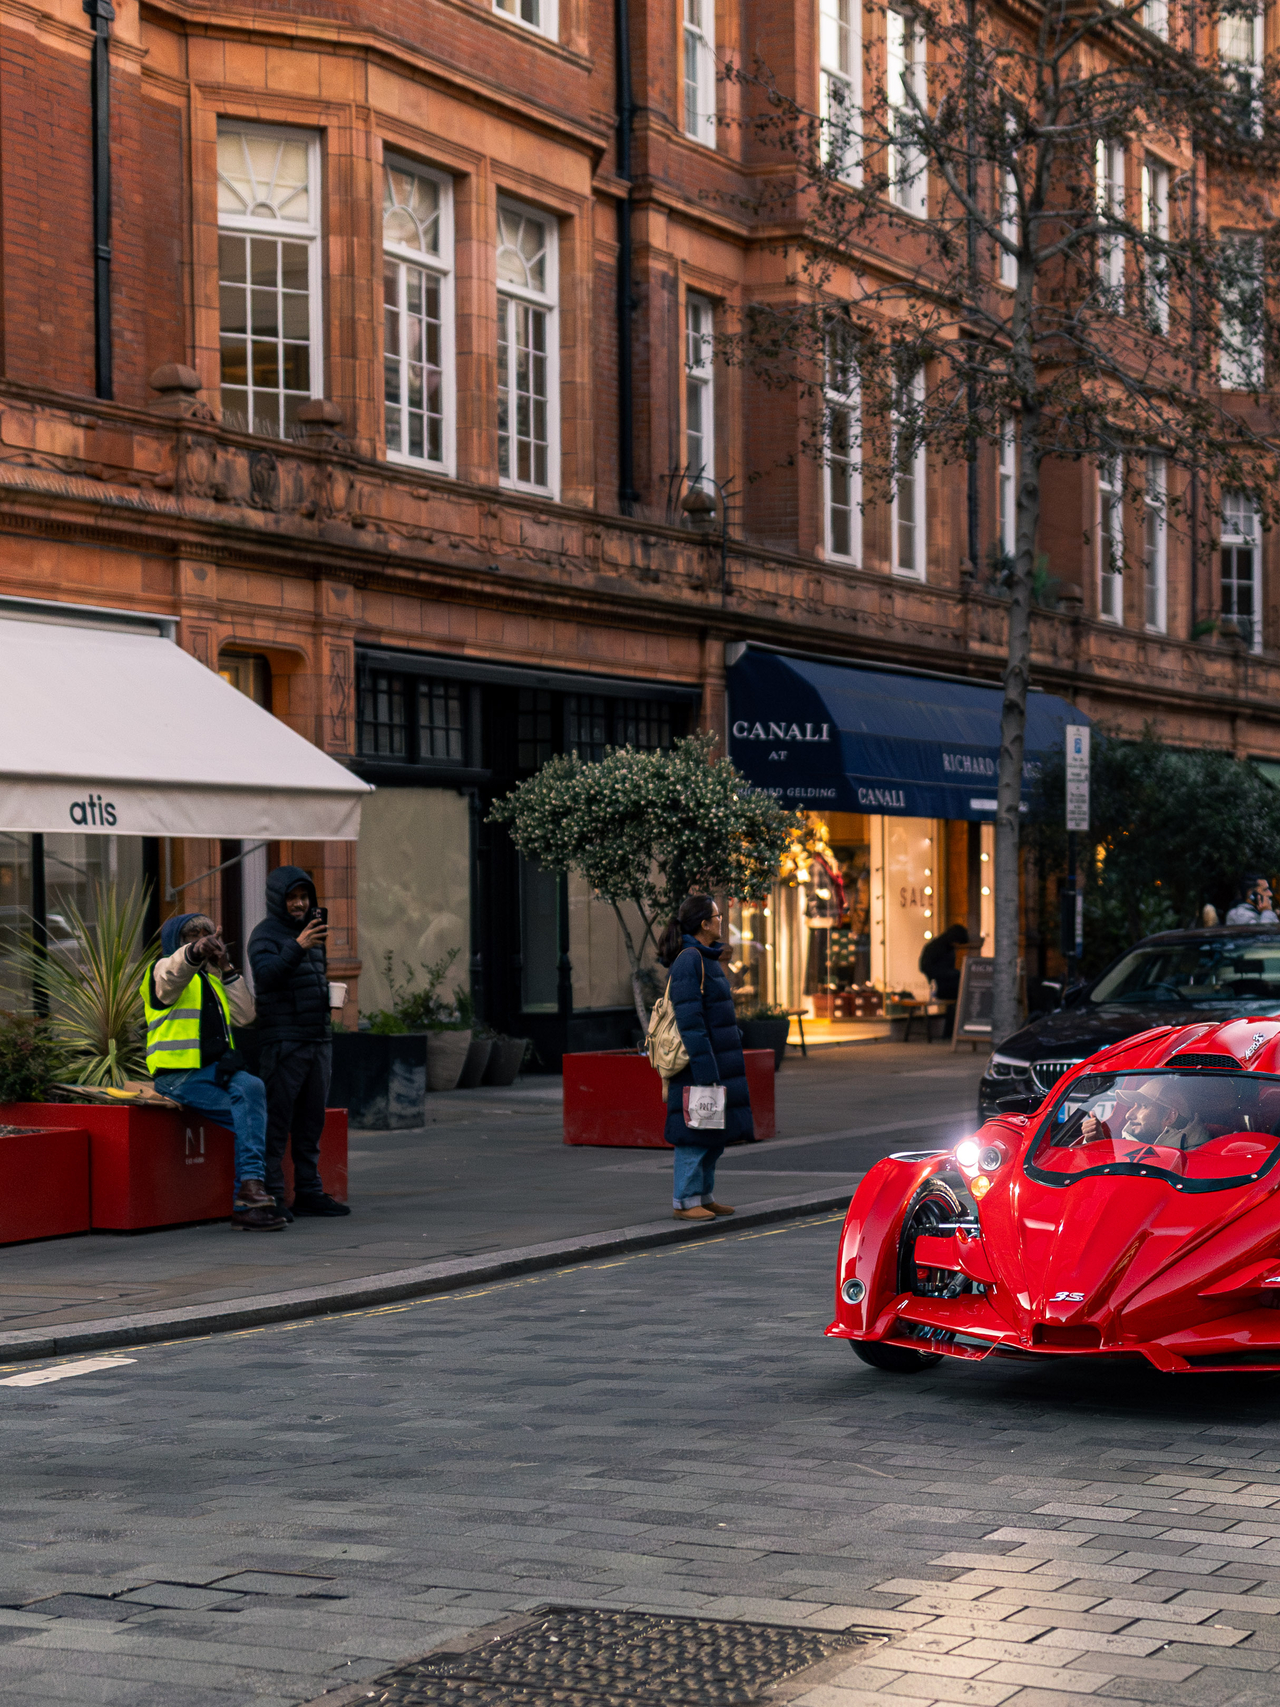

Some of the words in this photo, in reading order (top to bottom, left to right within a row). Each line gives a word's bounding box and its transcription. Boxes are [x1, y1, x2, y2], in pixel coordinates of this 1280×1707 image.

[733, 720, 830, 741] CANALI
[768, 750, 788, 761] AT
[943, 752, 995, 776] RICHARD
[786, 787, 837, 798] GELDING
[858, 787, 906, 807] CANALI
[69, 793, 117, 826] atis
[1048, 1291, 1085, 1302] 3S
